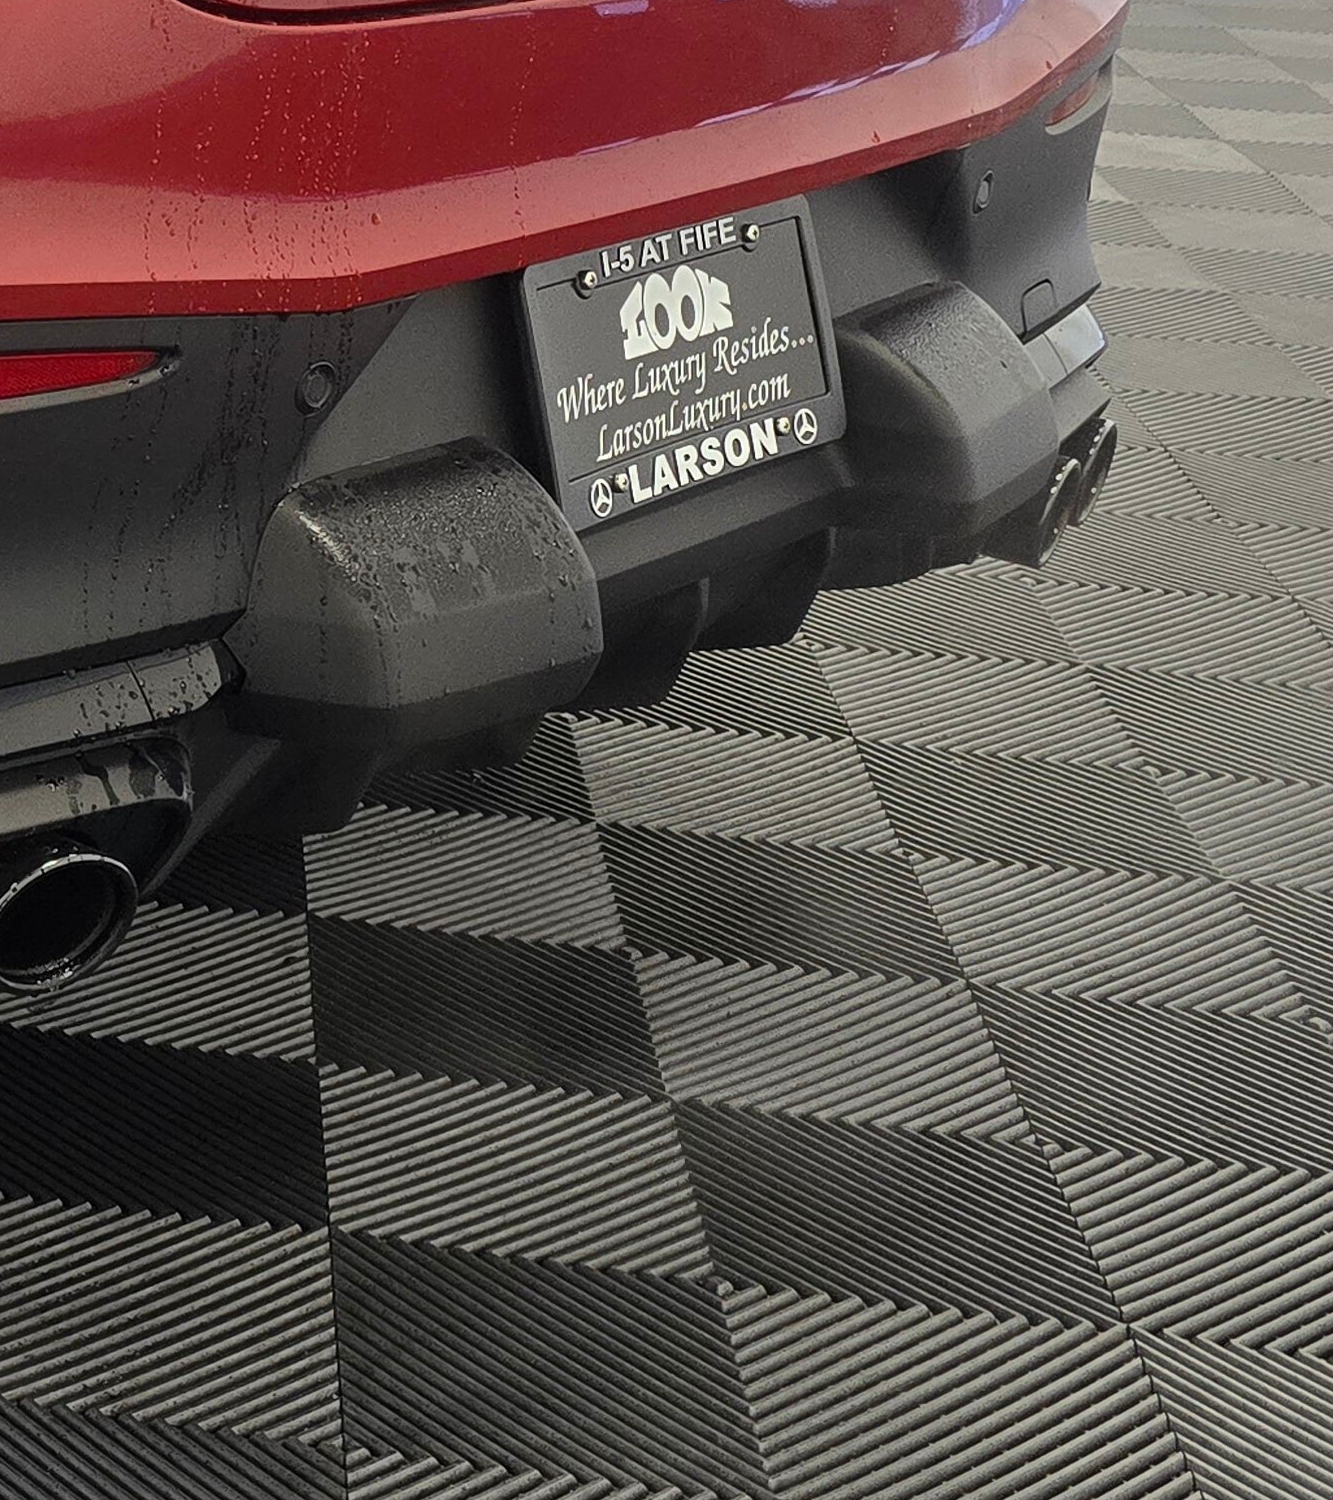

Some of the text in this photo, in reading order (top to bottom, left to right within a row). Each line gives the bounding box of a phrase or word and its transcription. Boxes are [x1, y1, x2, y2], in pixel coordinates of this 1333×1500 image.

[600, 215, 738, 278] I-5 AT FIFE
[618, 264, 734, 361] LOOK
[556, 316, 815, 424] Where Luxury Resides...
[596, 372, 792, 463] LarsonLuxury.com
[627, 417, 779, 505] LARSON
